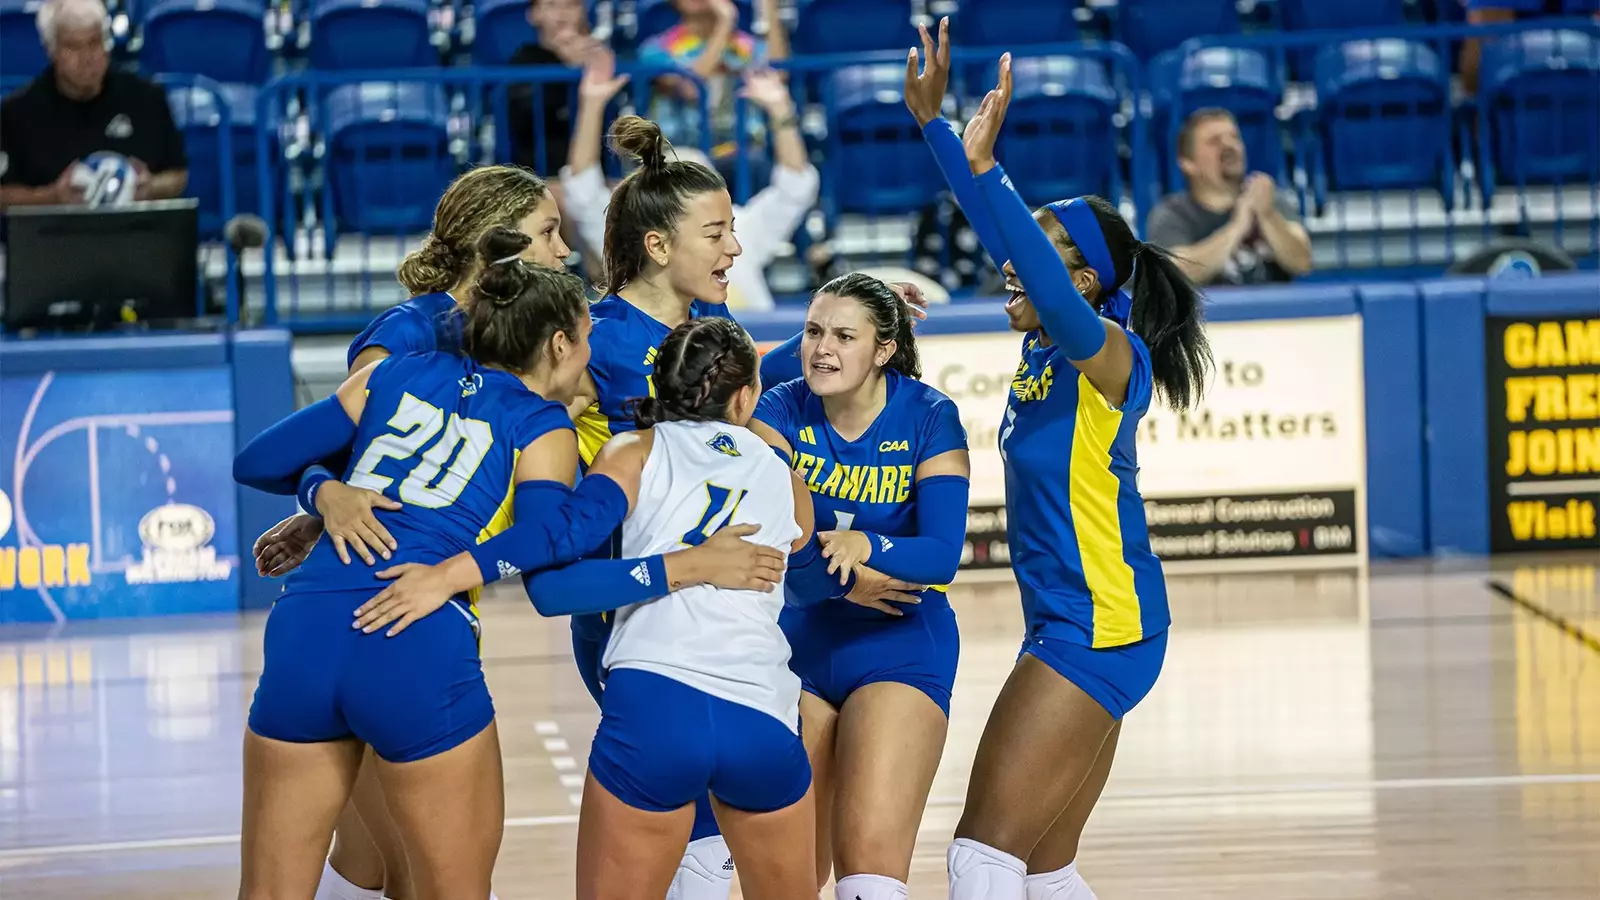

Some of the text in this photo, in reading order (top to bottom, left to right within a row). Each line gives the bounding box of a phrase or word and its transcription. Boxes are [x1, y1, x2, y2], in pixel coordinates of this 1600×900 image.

[1223, 359, 1265, 388] to
[1505, 374, 1600, 423] FRE
[1178, 409, 1338, 440] Matters
[346, 391, 494, 509] 20
[879, 440, 909, 452] CAA
[1145, 495, 1335, 526] General Construction
[1507, 499, 1596, 540] Visit
[1215, 529, 1295, 554] Solutions
[1313, 525, 1351, 550] BIM
